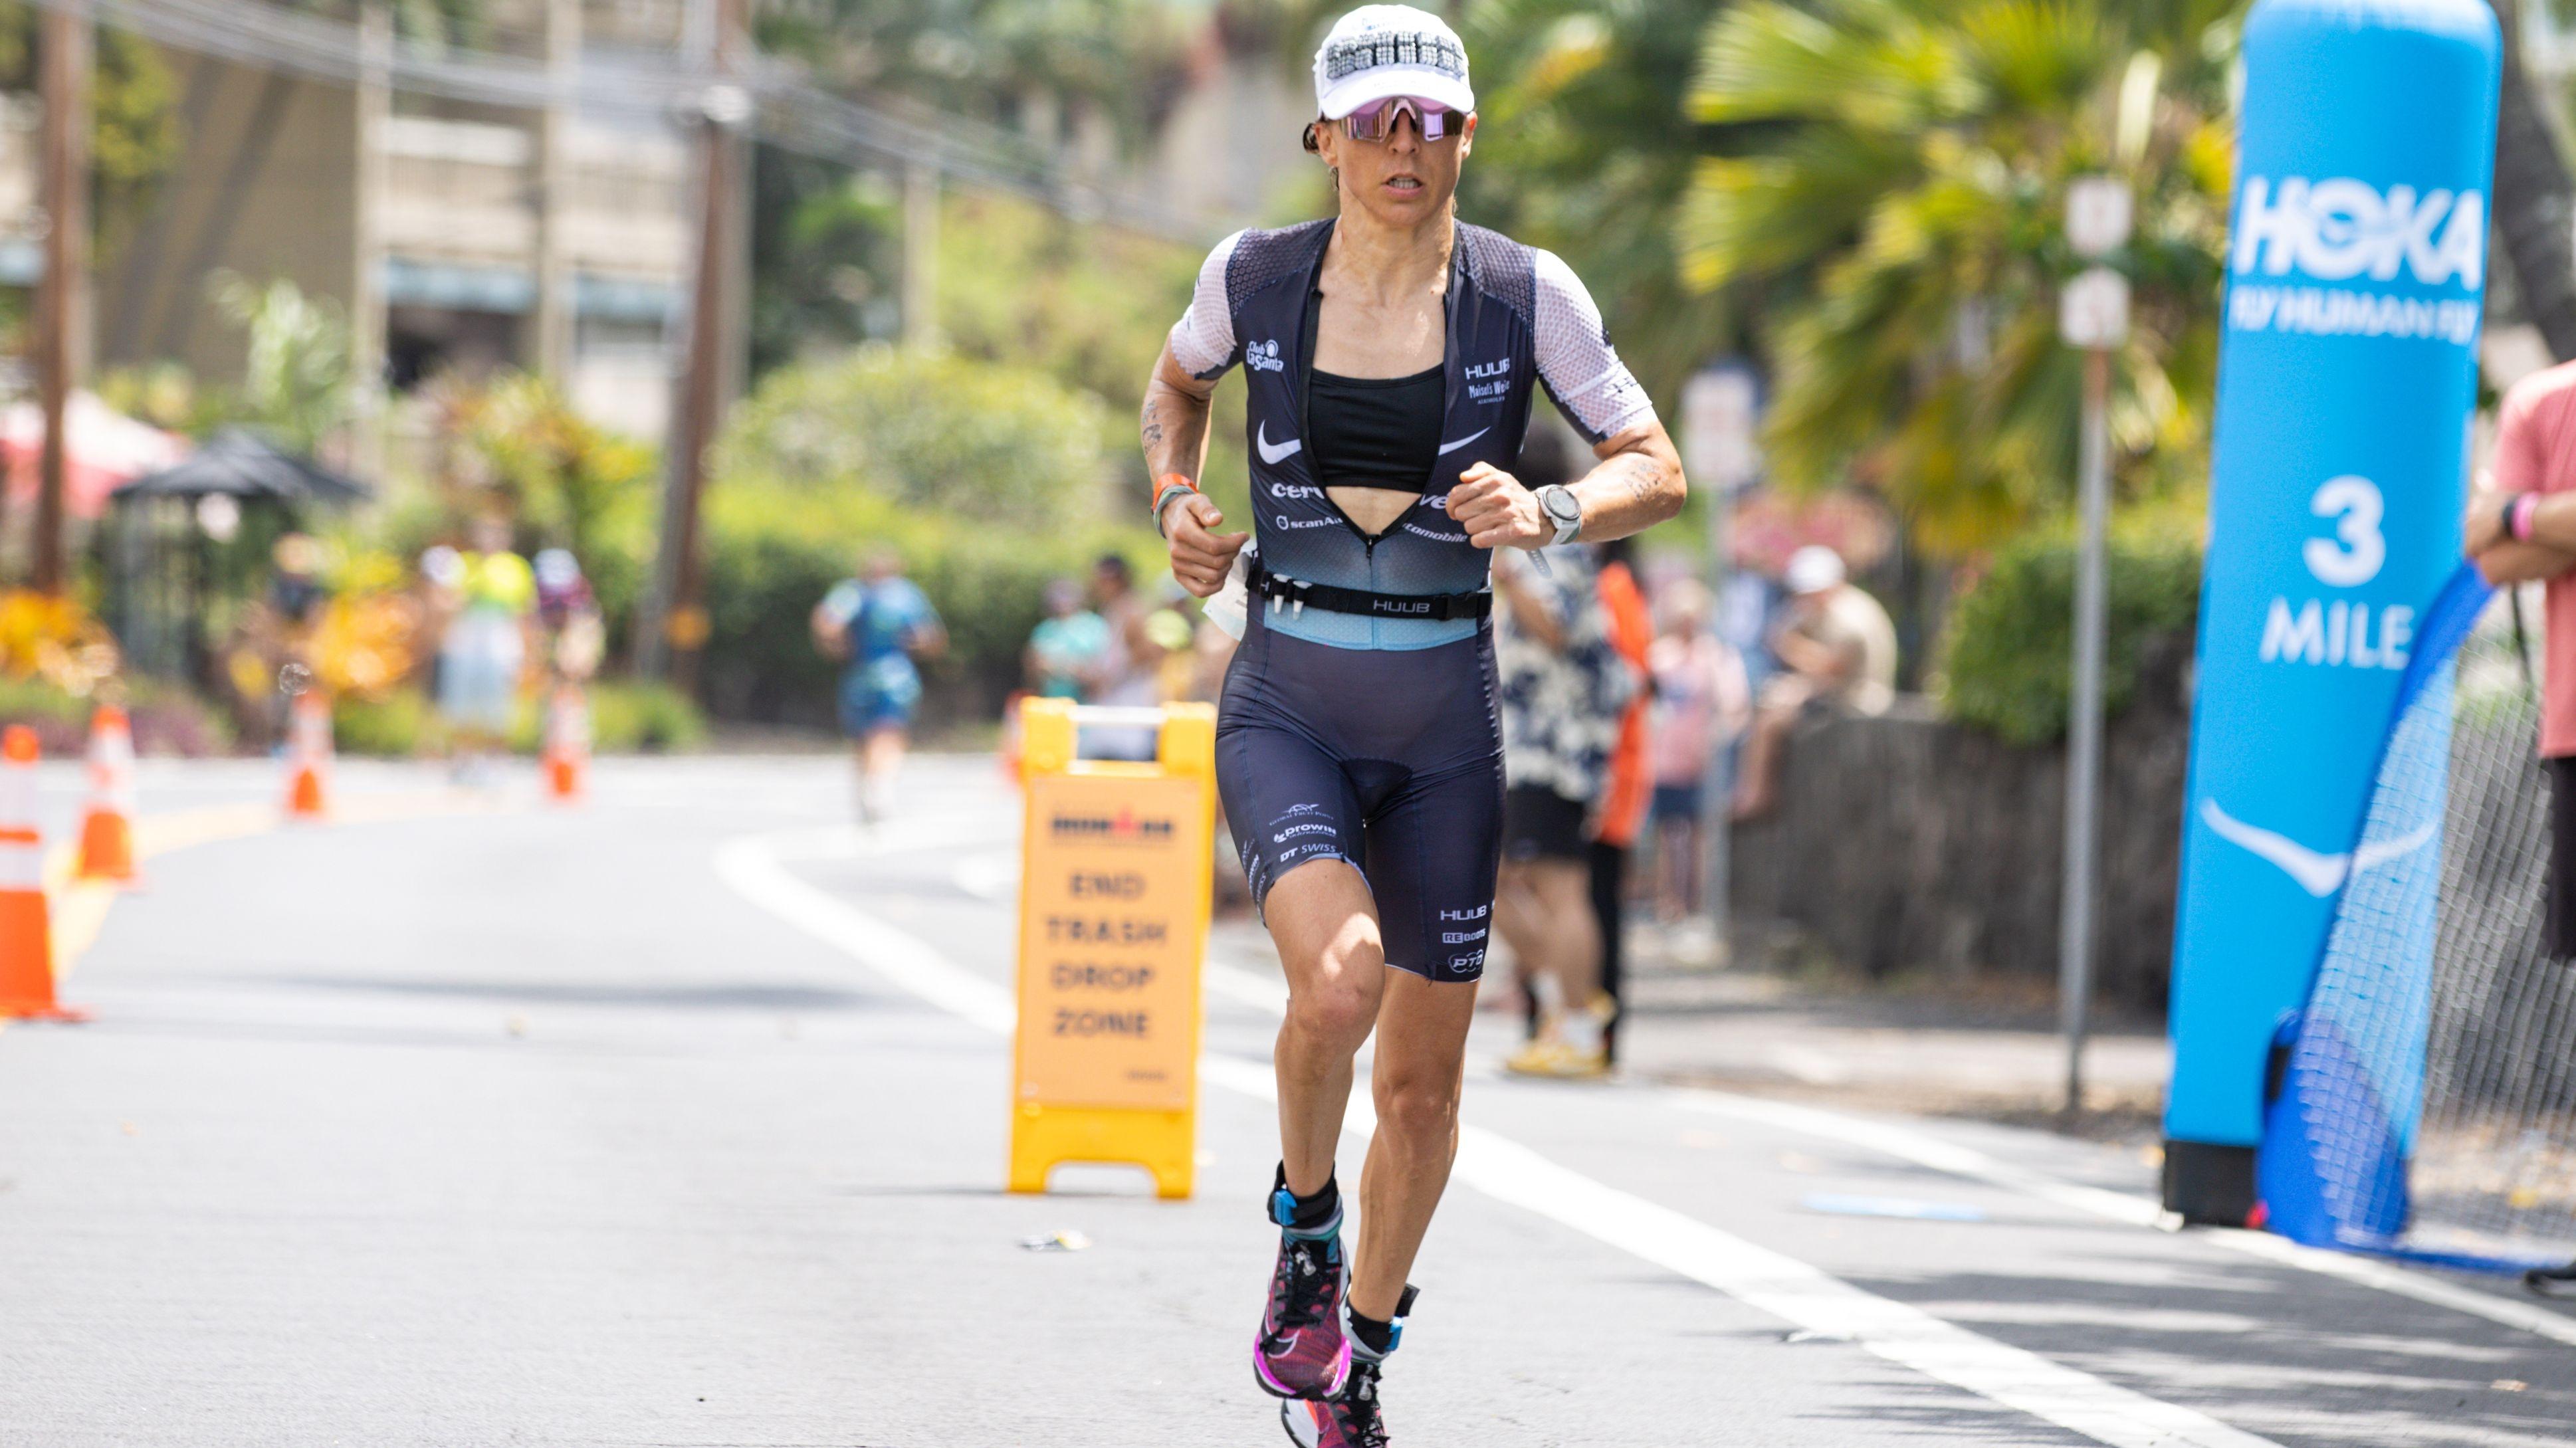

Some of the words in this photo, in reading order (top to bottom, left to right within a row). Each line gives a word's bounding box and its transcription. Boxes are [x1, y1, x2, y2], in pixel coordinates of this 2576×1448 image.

[2232, 175, 2484, 291] HOKA
[2278, 287, 2435, 339] HUMAN
[1249, 340, 1265, 356] Club
[1465, 358, 1510, 380] HUUB
[2302, 473, 2386, 588] 3
[1373, 599, 1430, 613] HUUB
[2259, 594, 2416, 671] MILE
[1280, 847, 1298, 863] DT
[1301, 843, 1337, 854] SWISS
[1071, 872, 1145, 899] END
[1440, 905, 1487, 920] HUUB
[1047, 914, 1168, 945] TRASH
[1051, 966, 1154, 990] DROP
[1054, 1009, 1149, 1039] ZONE
